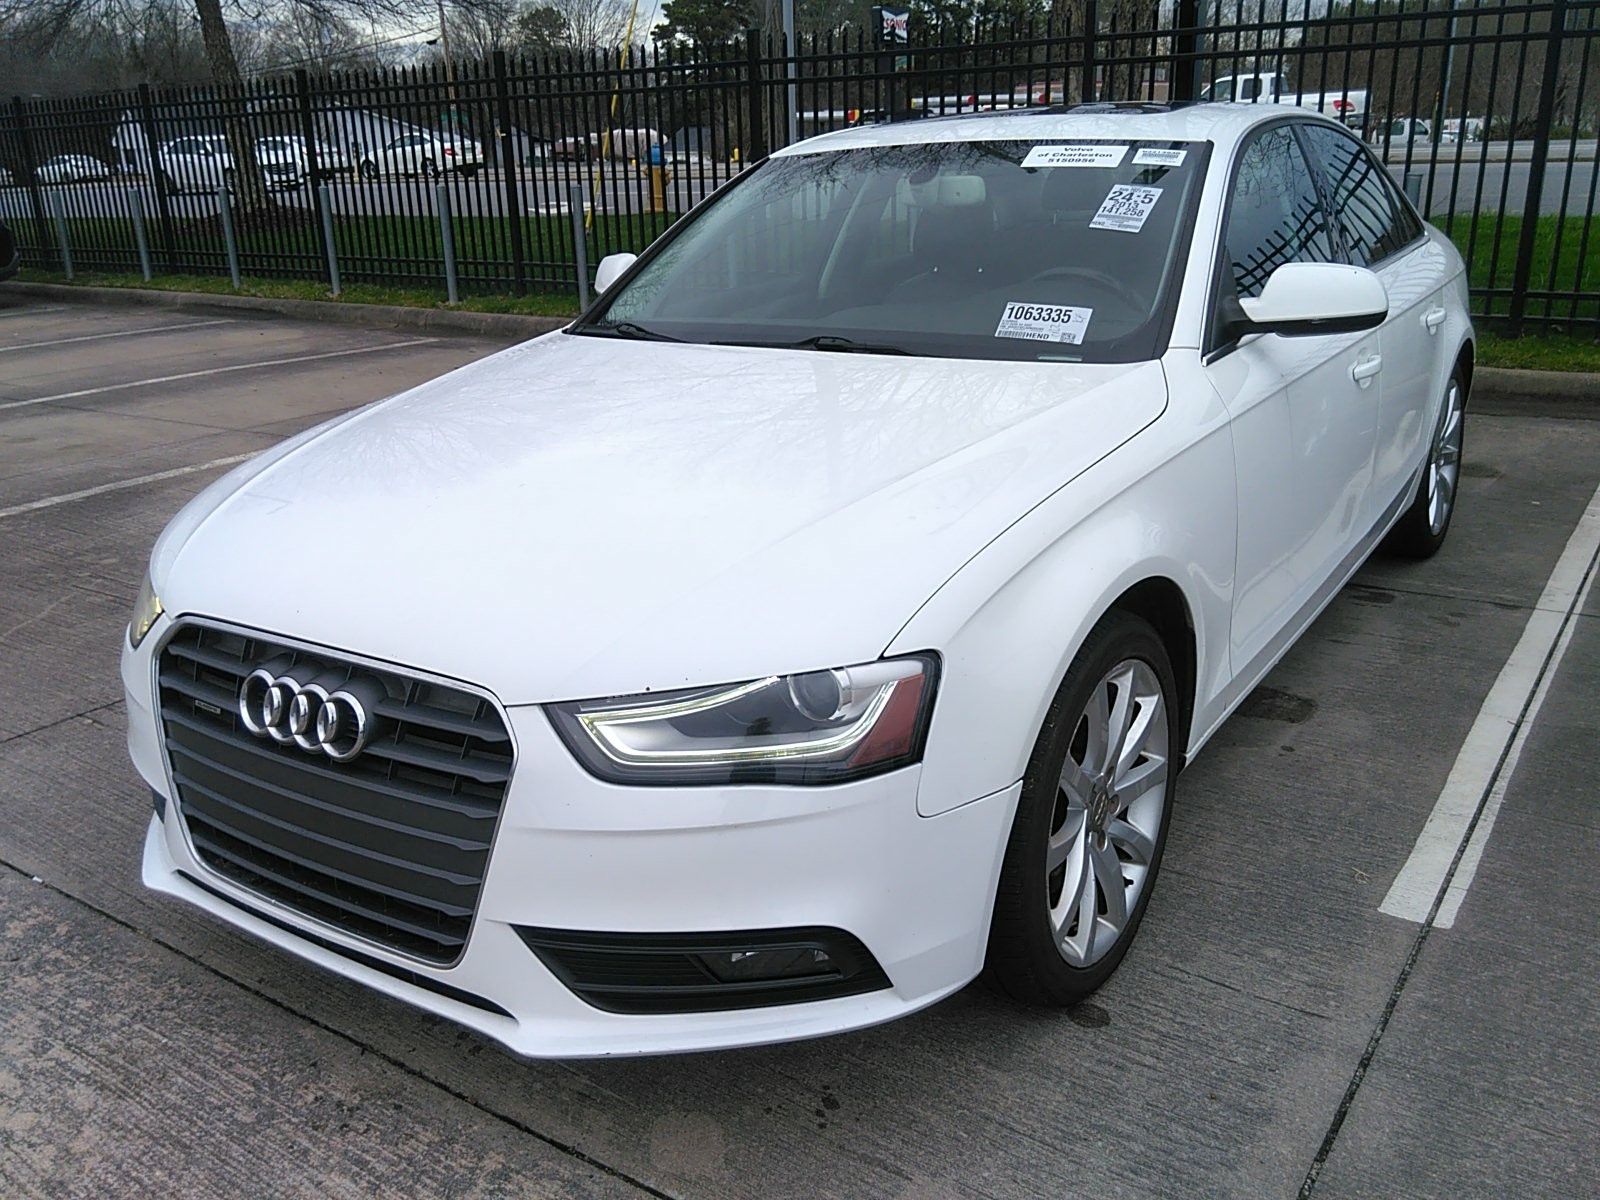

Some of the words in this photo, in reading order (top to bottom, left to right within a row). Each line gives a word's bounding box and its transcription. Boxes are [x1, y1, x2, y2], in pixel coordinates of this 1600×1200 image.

[1112, 200, 1139, 209] 2013
[1007, 306, 1073, 323] 1063335
[1025, 332, 1050, 340] HEND
